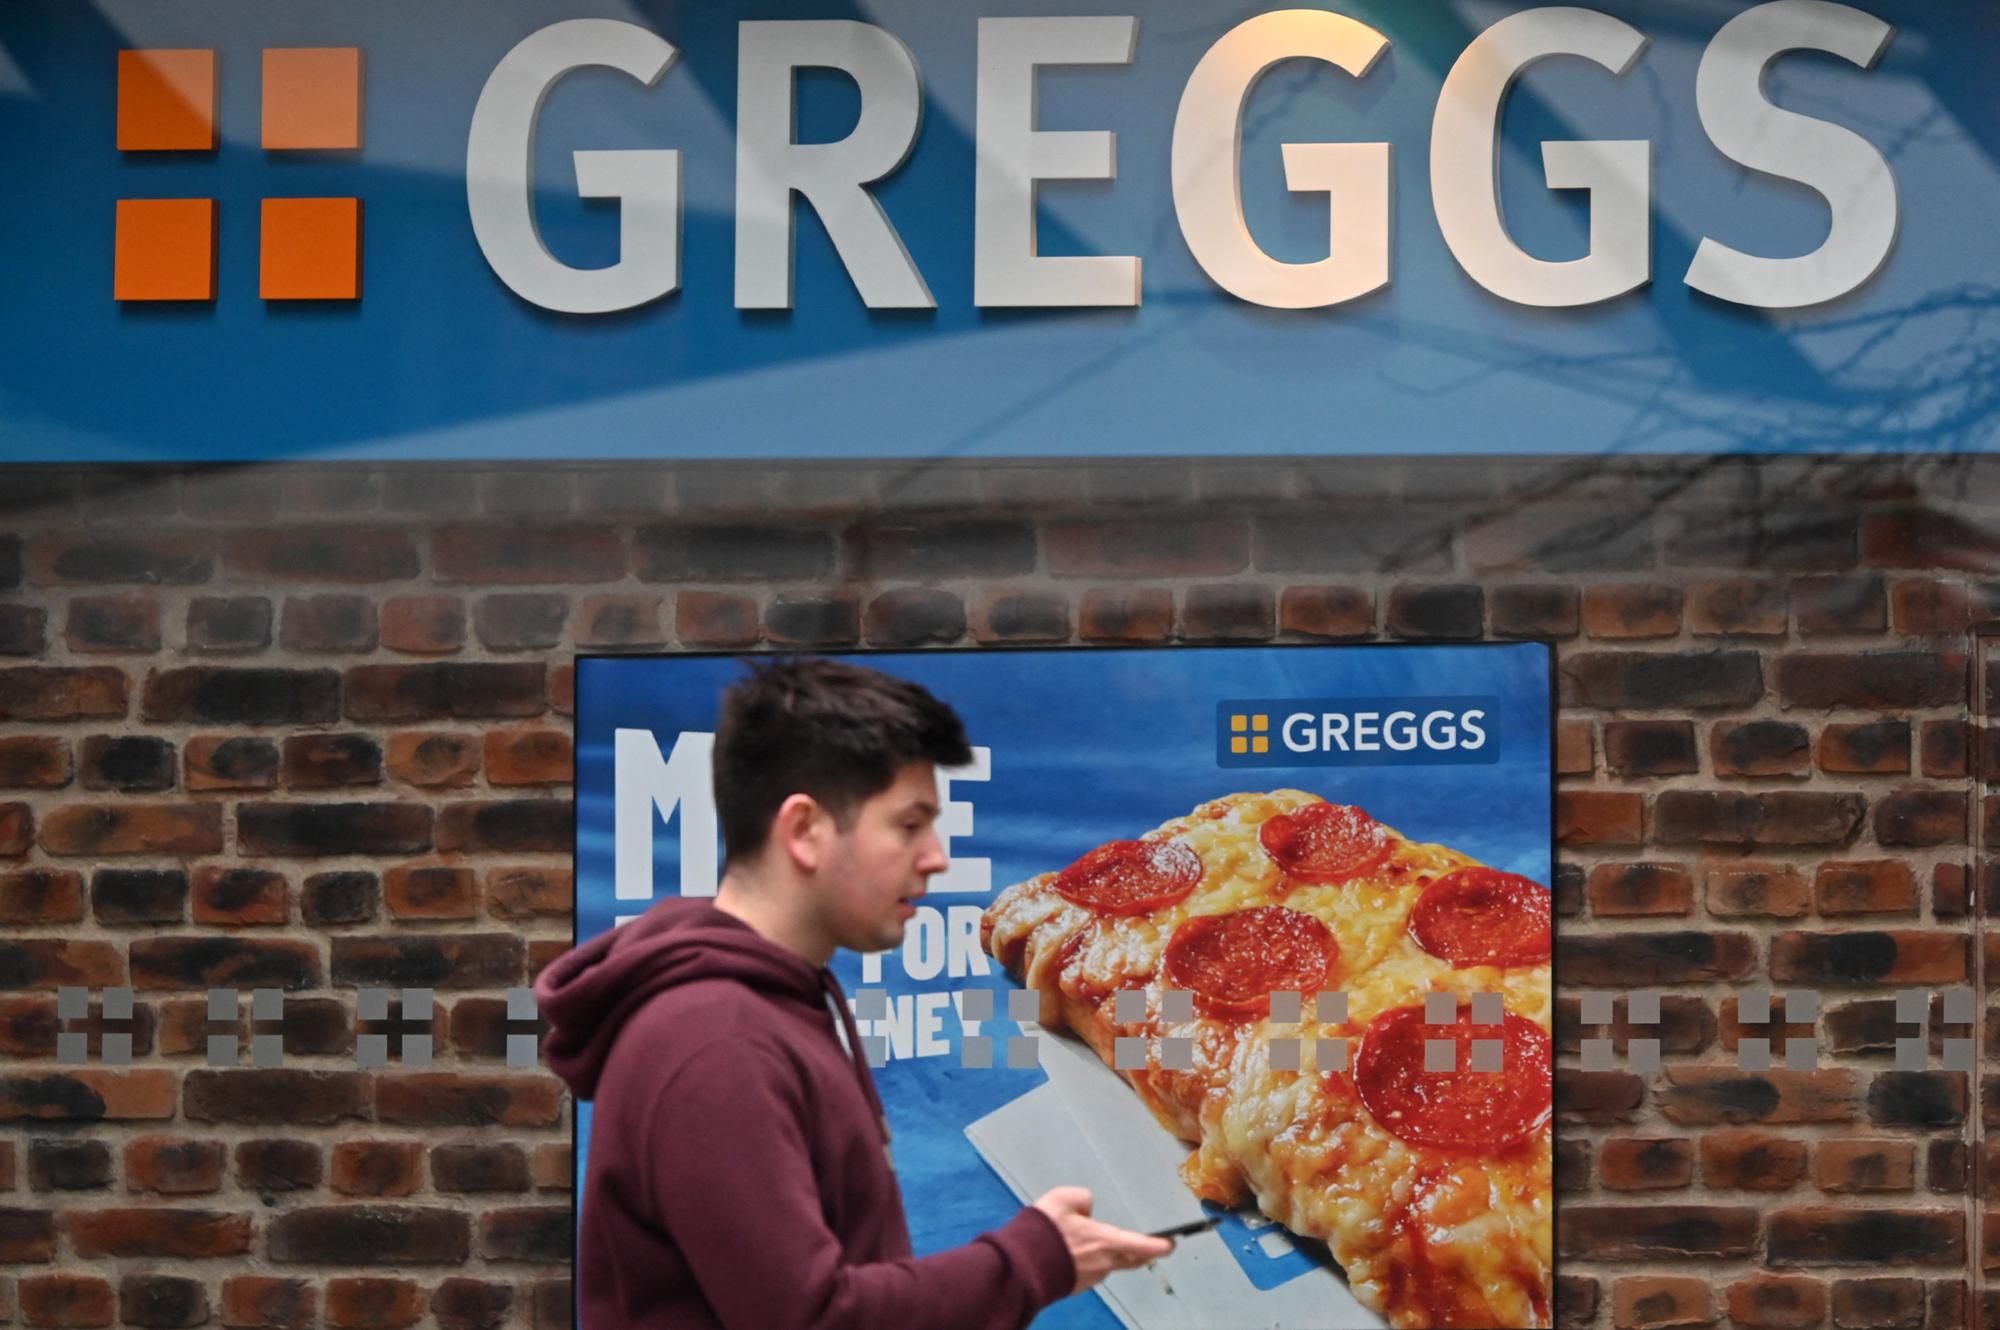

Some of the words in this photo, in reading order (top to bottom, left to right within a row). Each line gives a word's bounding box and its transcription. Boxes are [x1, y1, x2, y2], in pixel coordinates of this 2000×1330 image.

[466, 1, 1897, 313] GREGGS
[615, 728, 991, 899] ME
[1282, 709, 1486, 752] GREGGS
